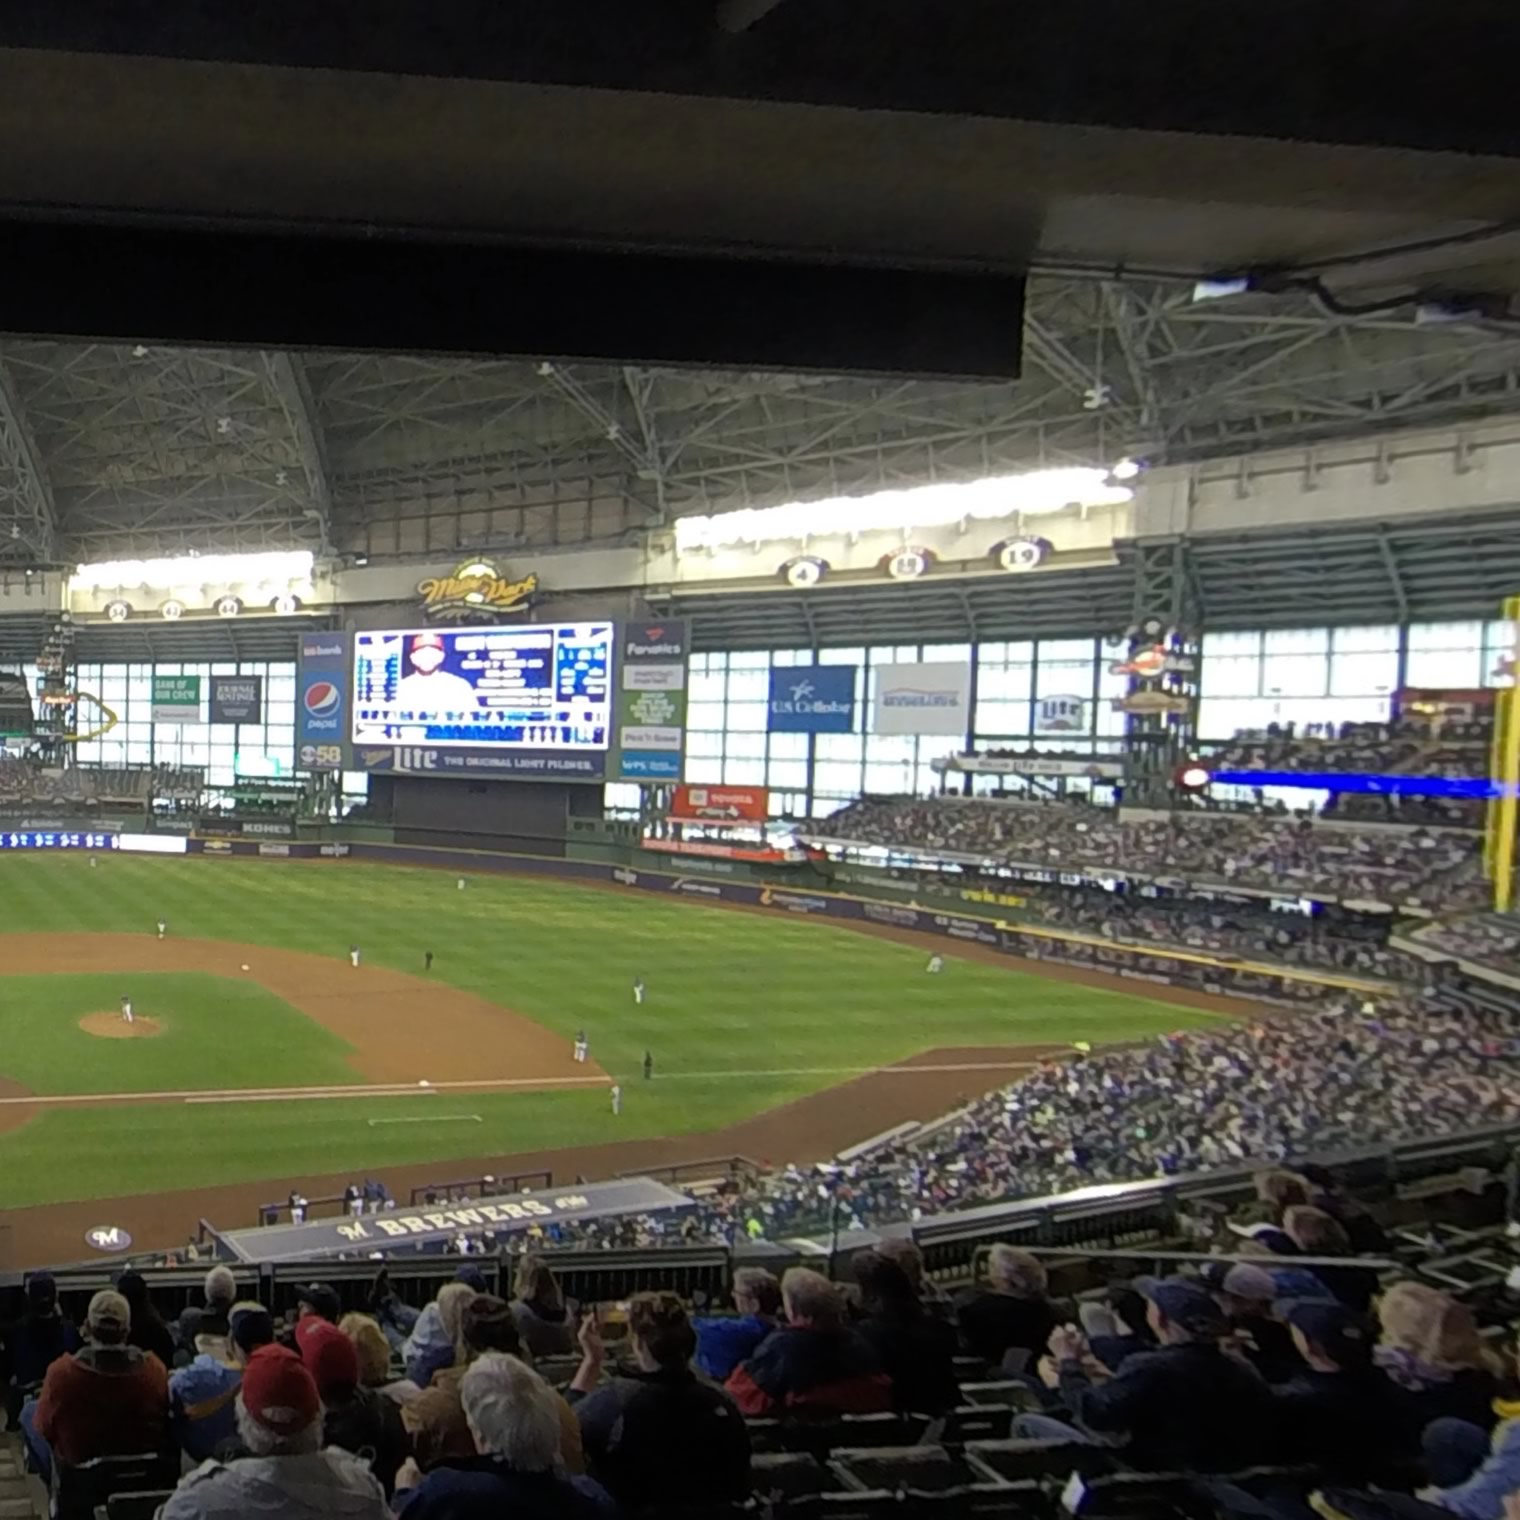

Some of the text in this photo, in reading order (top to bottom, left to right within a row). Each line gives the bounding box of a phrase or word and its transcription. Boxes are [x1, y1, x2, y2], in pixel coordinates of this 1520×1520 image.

[1008, 549, 1034, 564] 19
[417, 572, 537, 605] Miller Park
[626, 643, 681, 656] Fanatics
[154, 690, 196, 700] OUR CREW
[1042, 700, 1080, 719] Lite
[307, 719, 338, 730] pepsi
[317, 745, 341, 763] 58
[392, 747, 438, 772] Lite
[444, 756, 464, 767] THE
[466, 756, 513, 768] ORIGINAL
[514, 757, 546, 770] LIGHT
[710, 793, 753, 805] TOYOTA
[336, 1220, 370, 1241] M
[376, 1199, 553, 1236] BREWERS
[91, 1226, 119, 1247] M
